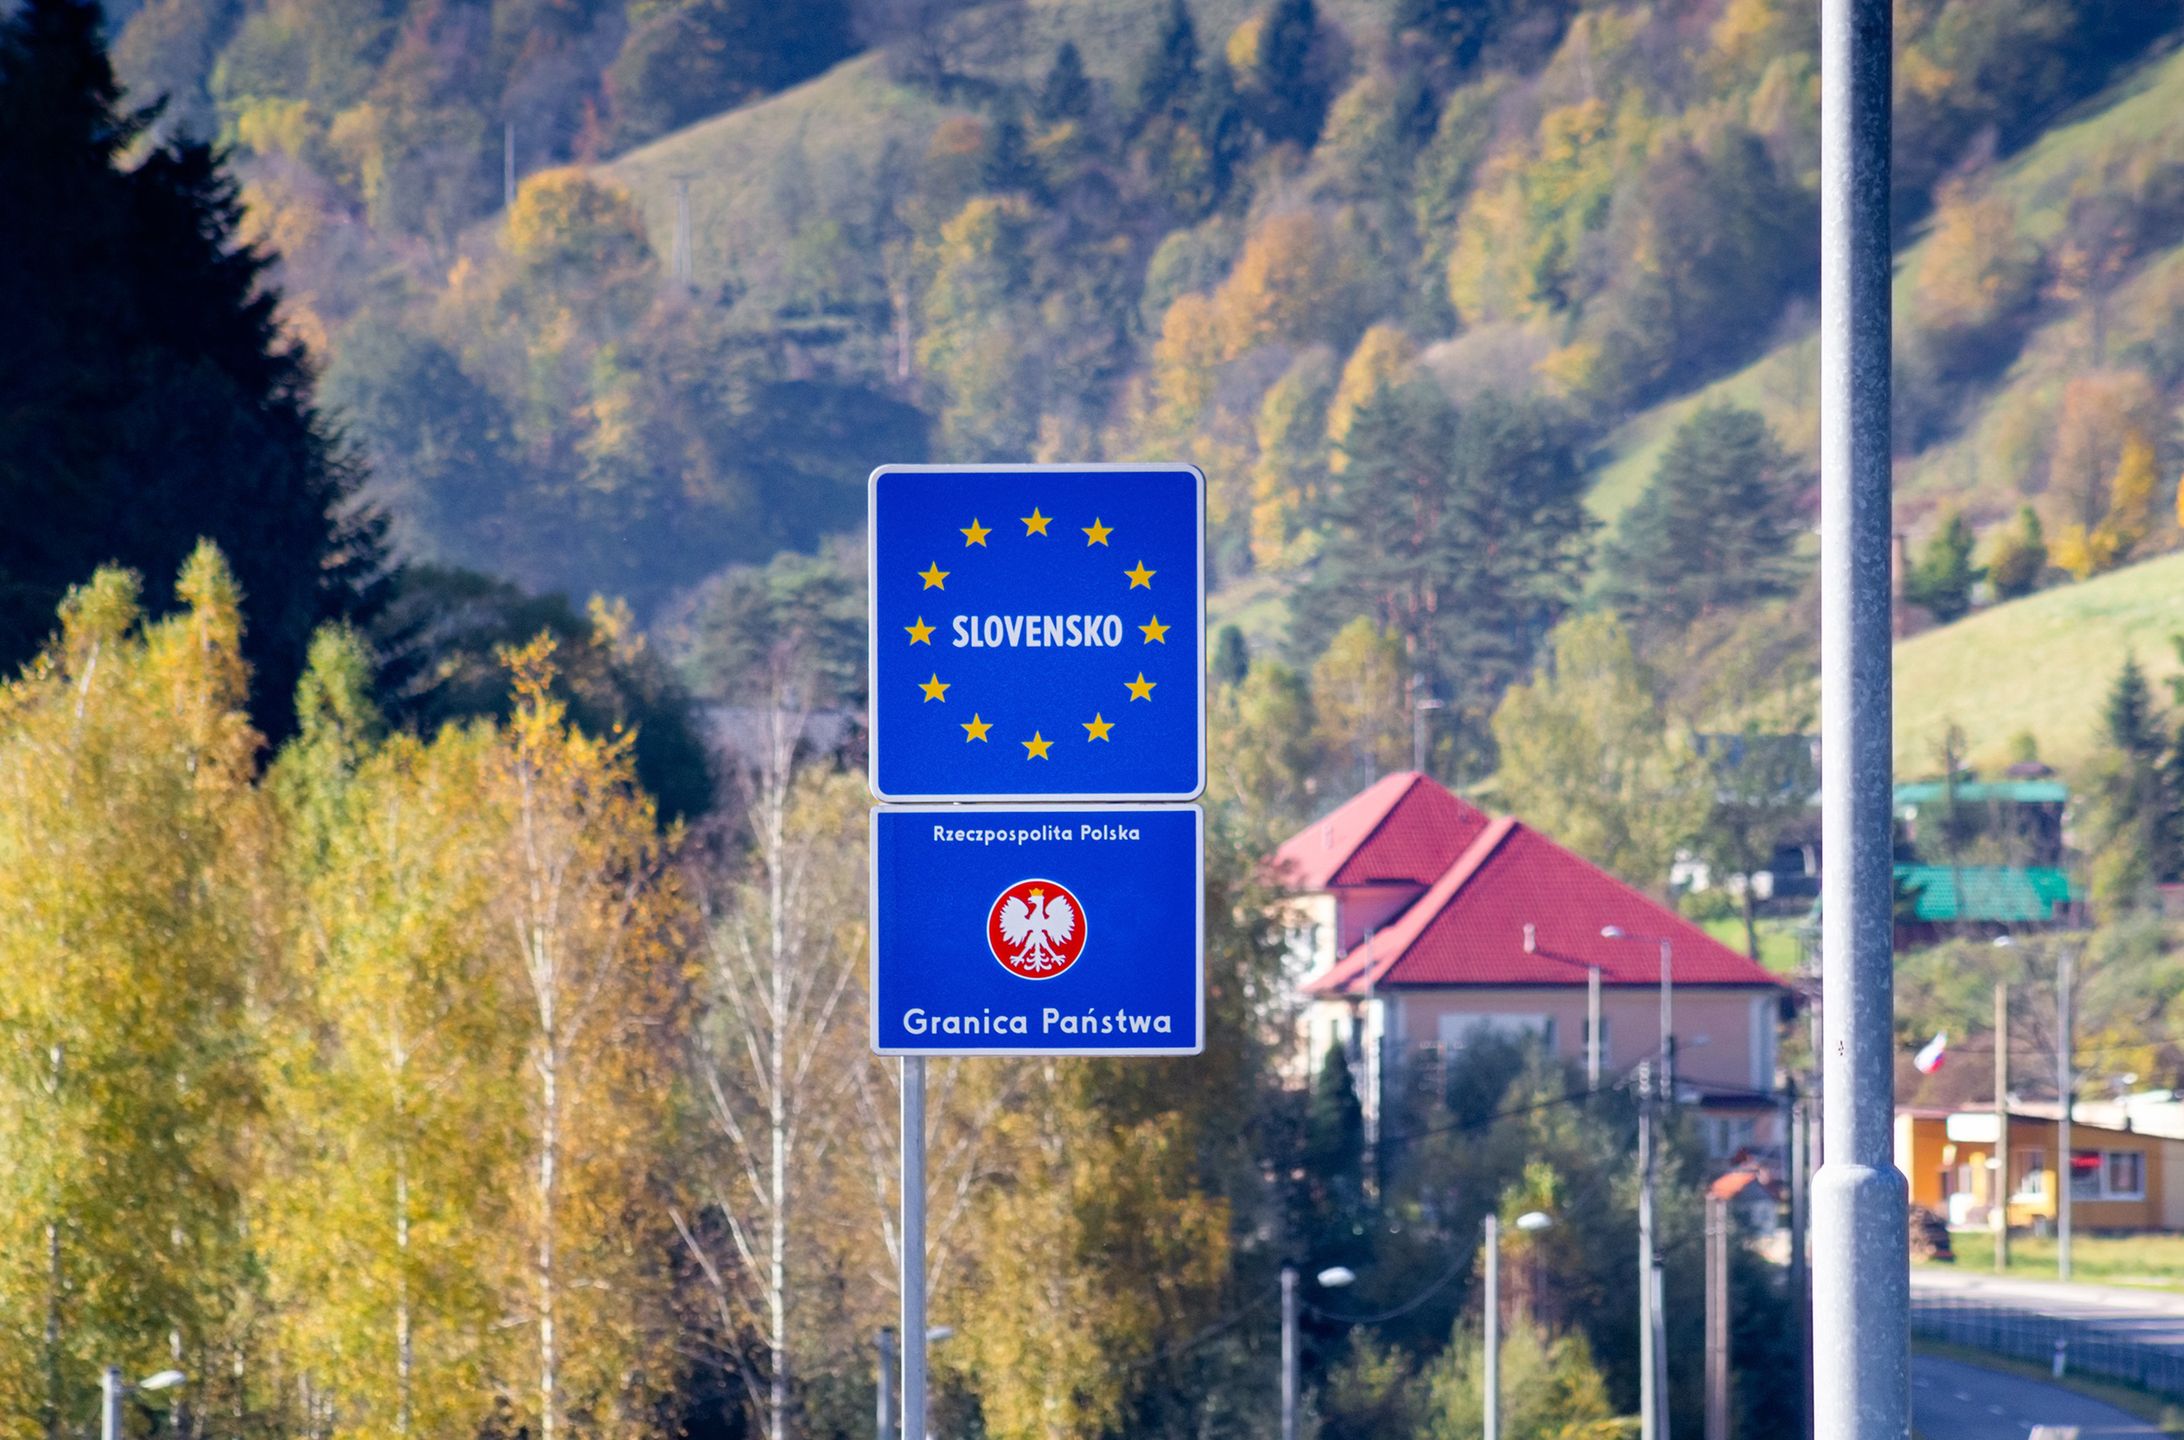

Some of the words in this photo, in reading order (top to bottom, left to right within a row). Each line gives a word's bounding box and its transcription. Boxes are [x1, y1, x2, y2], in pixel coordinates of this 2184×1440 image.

[953, 614, 1123, 648] SLOVENSKO
[933, 825, 1073, 846] Rzeczpospolita
[1080, 824, 1141, 841] Polska
[903, 1008, 1028, 1035] Granica
[1043, 1007, 1172, 1034] Państwa
